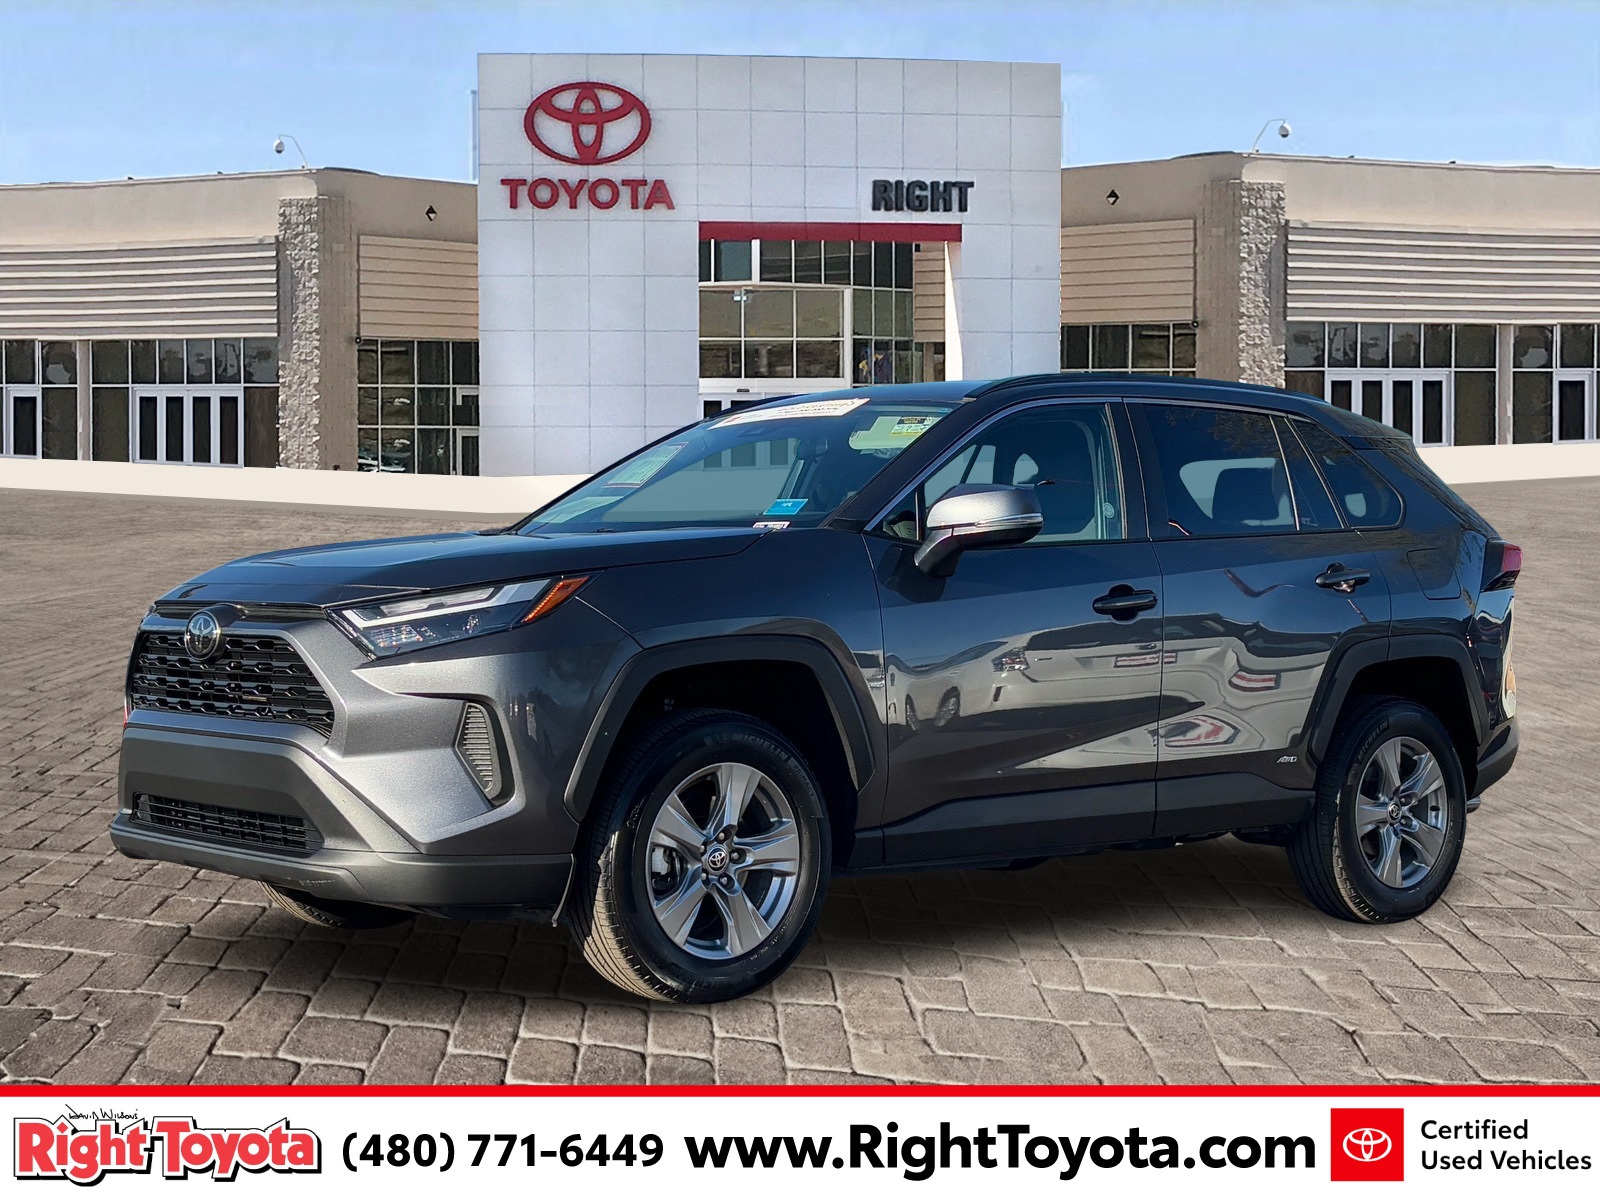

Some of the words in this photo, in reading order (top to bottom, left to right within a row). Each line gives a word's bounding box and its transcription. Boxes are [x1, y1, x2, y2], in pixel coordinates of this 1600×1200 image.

[500, 179, 675, 210] TOYOTA
[871, 180, 975, 212] RIGHT
[732, 733, 788, 761] MICHELIN
